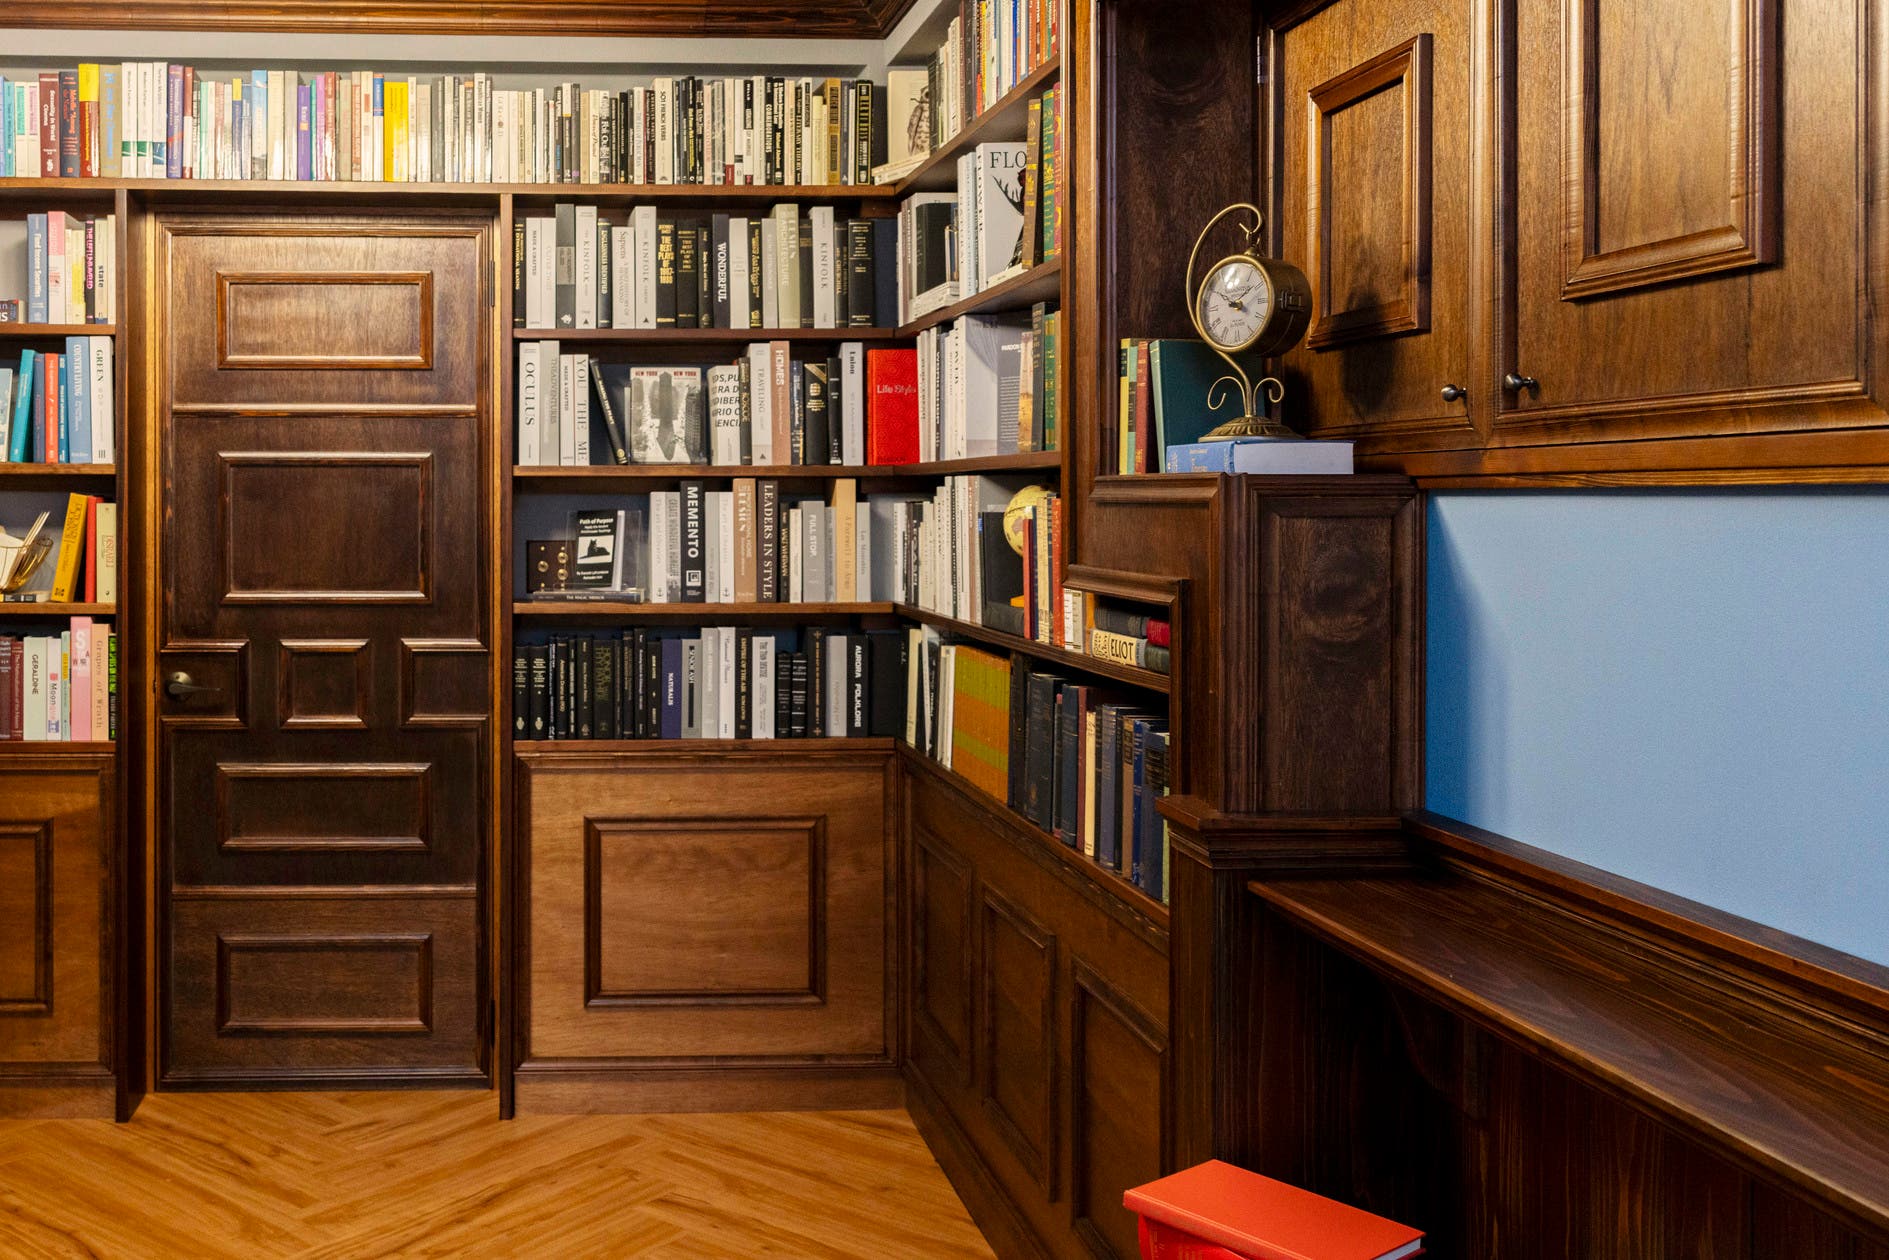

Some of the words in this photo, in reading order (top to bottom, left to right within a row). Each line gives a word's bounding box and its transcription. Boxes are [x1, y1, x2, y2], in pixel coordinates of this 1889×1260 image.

[765, 104, 773, 153] COMMEMORATIONS
[619, 231, 629, 259] Sapiens
[717, 242, 727, 303] WONDERFUL
[820, 242, 829, 290] KINFOLK
[73, 344, 82, 373] COUNTRY
[95, 349, 104, 382] GREEN
[577, 359, 587, 389] YOU
[775, 350, 785, 385] HOMES
[73, 373, 82, 396] LIVING
[525, 362, 535, 426] OCULUS
[757, 368, 765, 413] TRAVELING
[877, 384, 893, 395] Life
[894, 384, 917, 396] Style
[577, 399, 587, 431] THE
[577, 441, 587, 462] ME
[687, 486, 699, 558] MEMENTO
[763, 484, 774, 540] LEADERS
[809, 514, 818, 534] FULL
[763, 543, 774, 557] IN
[844, 523, 852, 556] Farewell
[763, 560, 774, 599] STYLE
[844, 560, 852, 568] to
[844, 571, 852, 590] Arms
[95, 640, 103, 674] Grapes
[595, 647, 604, 665] THY
[1110, 638, 1134, 661] ELIOT
[95, 681, 103, 692] of
[595, 667, 604, 701] FATHER
[95, 699, 103, 728] Wrath
